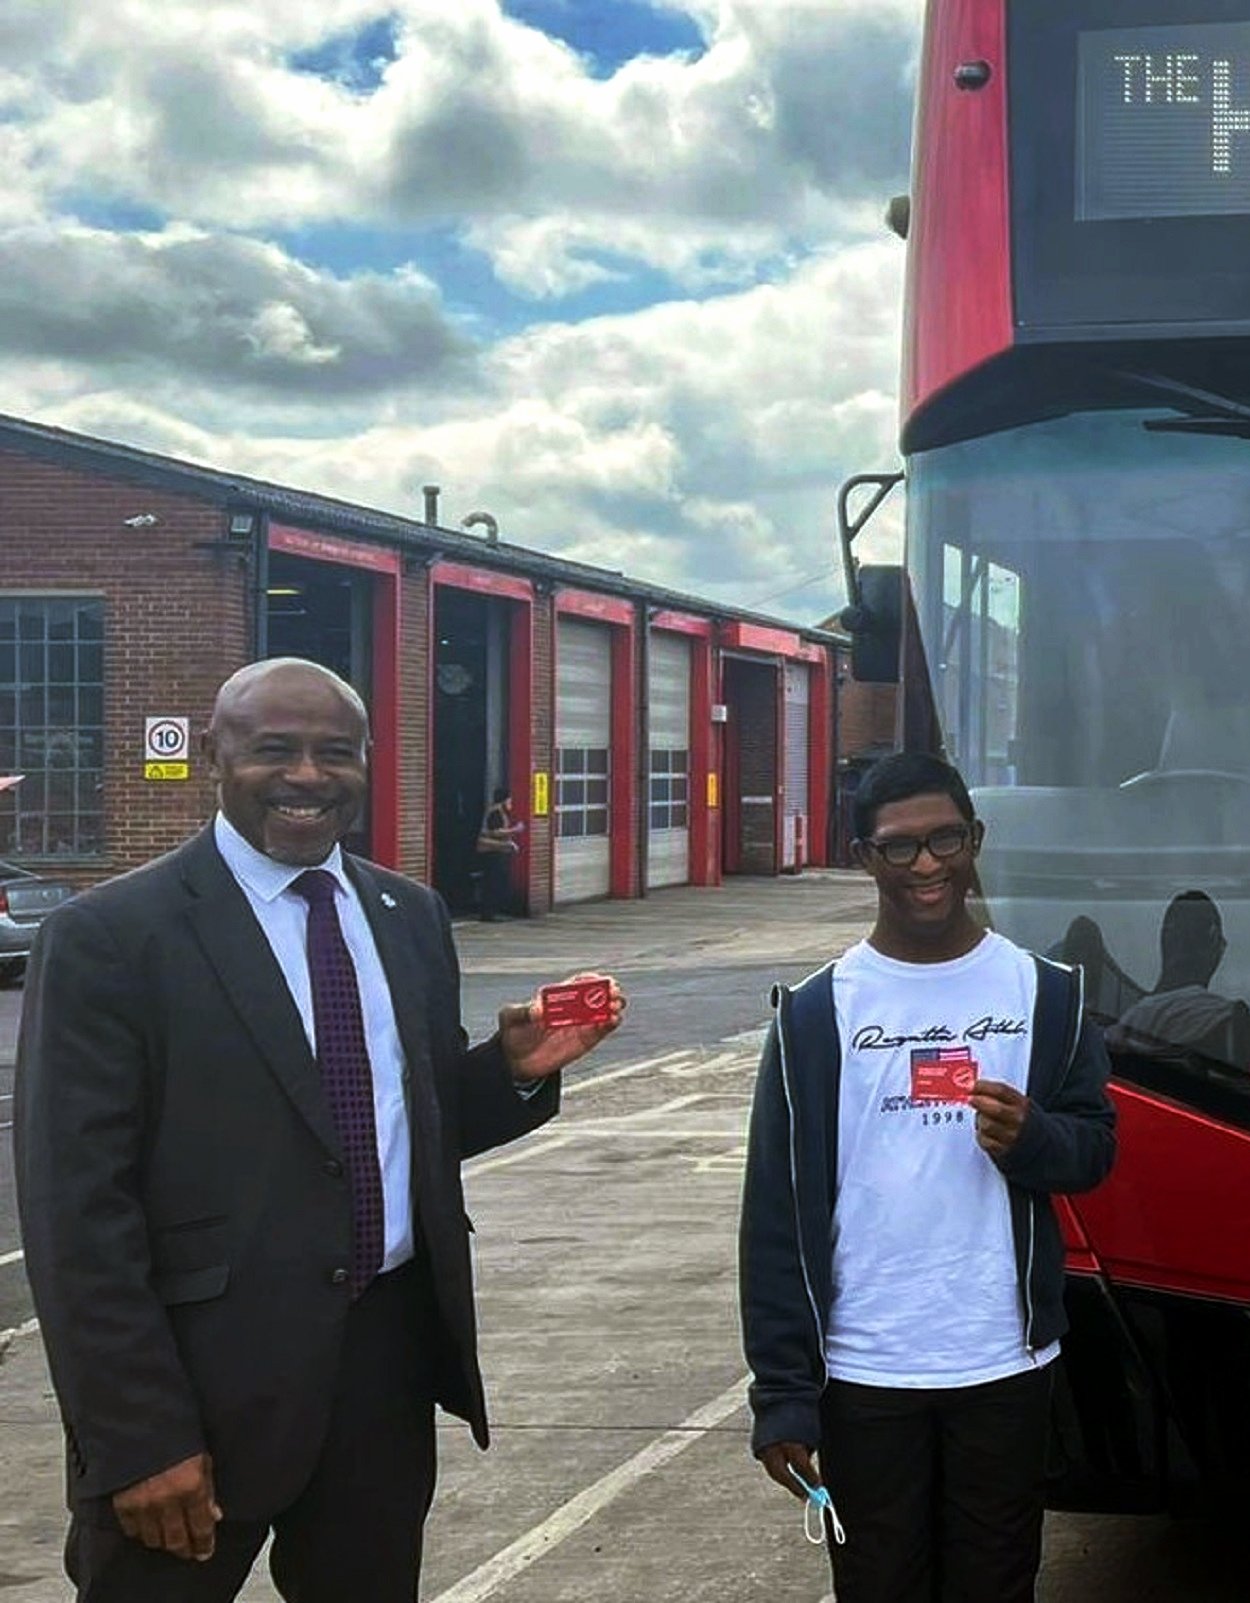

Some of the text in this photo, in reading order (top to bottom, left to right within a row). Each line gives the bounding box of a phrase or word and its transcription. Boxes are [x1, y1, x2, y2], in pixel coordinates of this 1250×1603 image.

[1114, 55, 1199, 103] THE
[156, 729, 180, 748] 10
[922, 1110, 964, 1126] 1998
